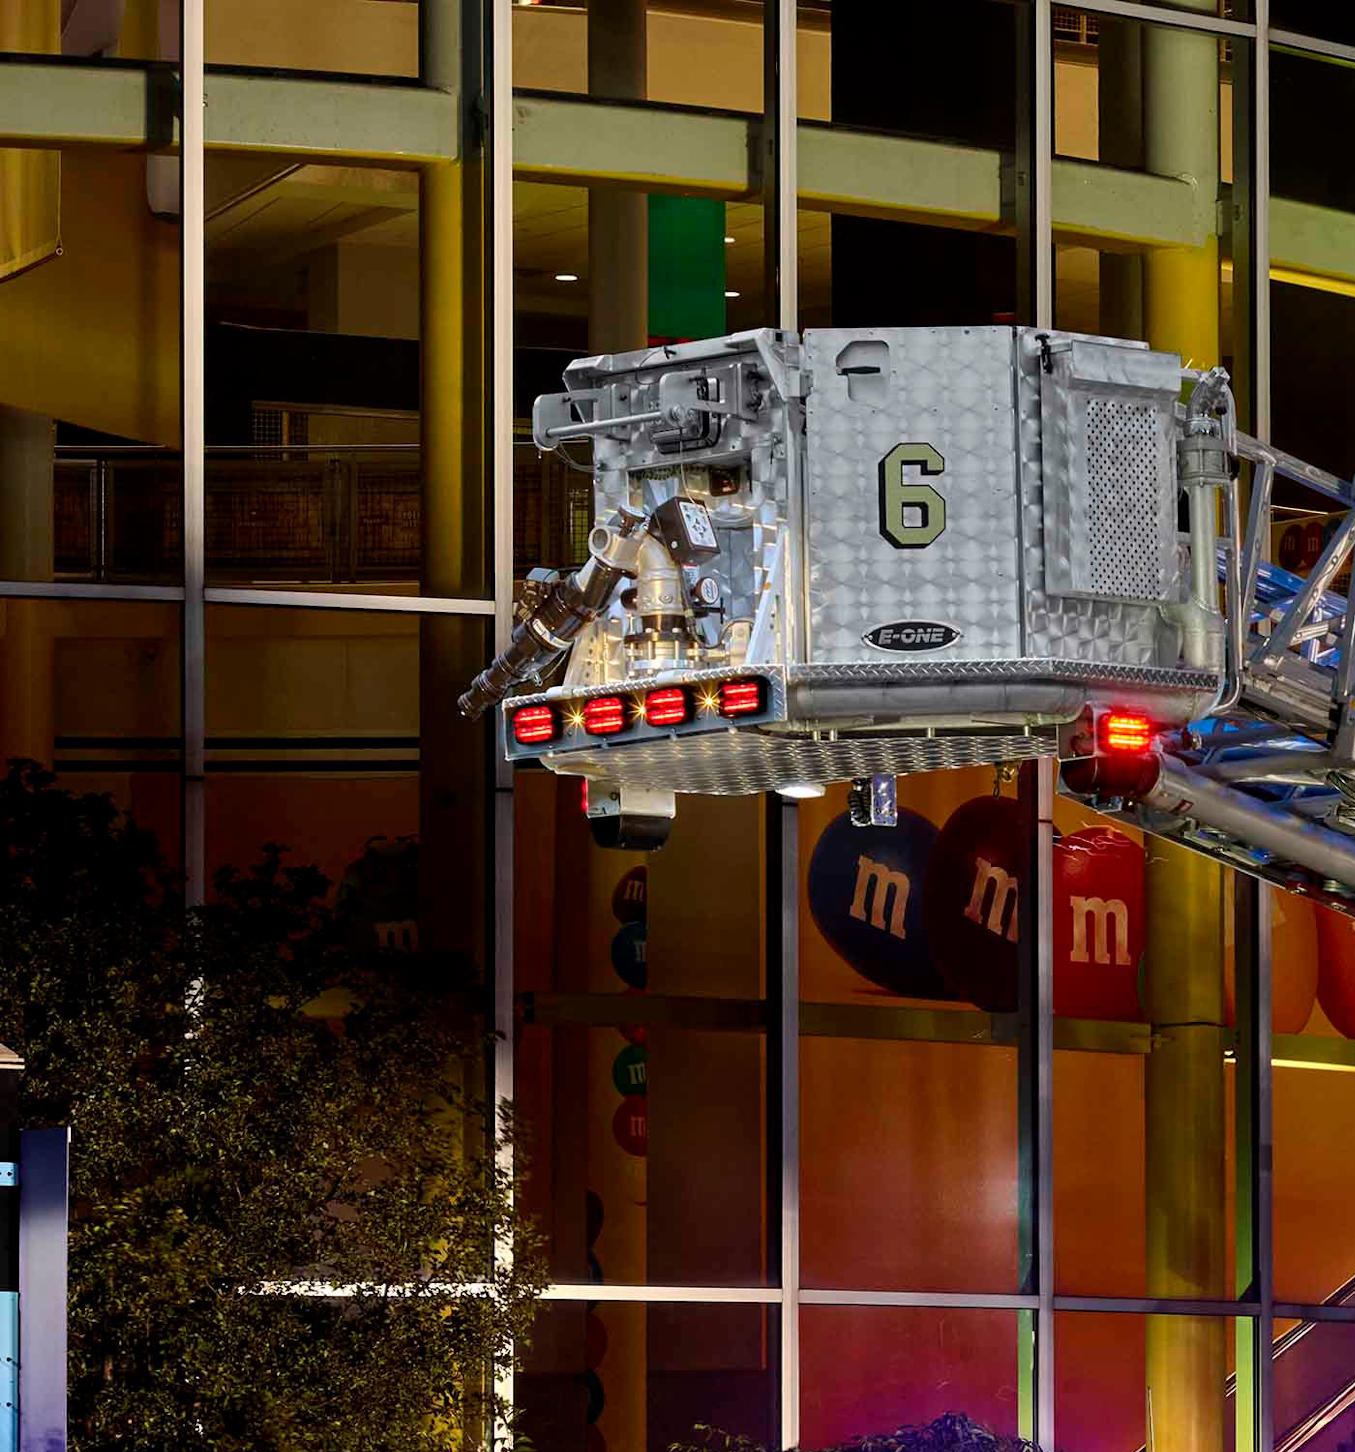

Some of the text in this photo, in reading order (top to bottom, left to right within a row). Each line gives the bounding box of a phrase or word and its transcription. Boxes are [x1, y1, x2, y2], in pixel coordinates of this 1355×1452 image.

[878, 441, 947, 550] 6
[878, 628, 945, 645] E-ONE
[850, 854, 911, 940] m
[1070, 895, 1131, 966] m
